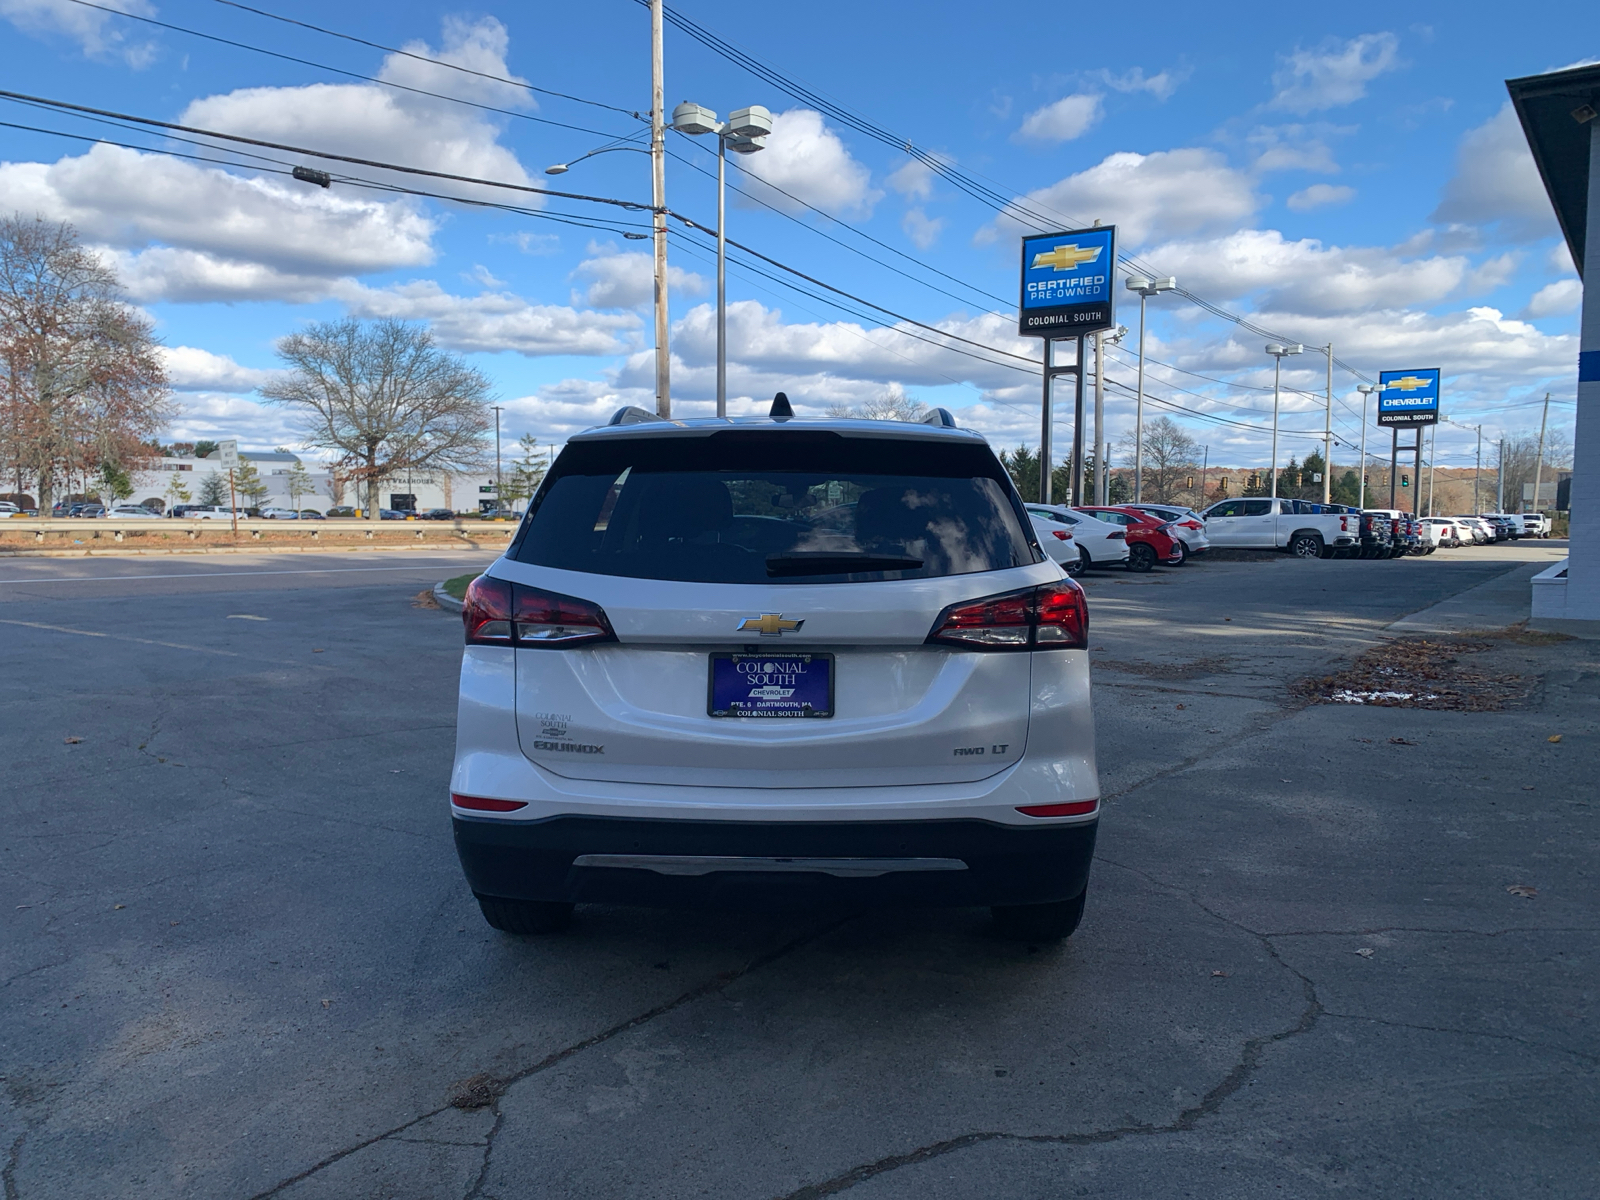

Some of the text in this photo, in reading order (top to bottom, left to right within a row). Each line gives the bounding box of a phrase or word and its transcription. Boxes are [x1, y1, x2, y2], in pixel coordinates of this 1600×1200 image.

[1027, 275, 1105, 292] CERTIFIED
[1030, 285, 1101, 300] PRE-OWNED
[1028, 311, 1102, 326] COLONIAL SOUTH
[1383, 397, 1435, 407] CHEVROLET
[736, 662, 807, 674] COLONIAL
[747, 673, 796, 685] SOUTH
[756, 701, 801, 709] DARTMOUTH,
[535, 712, 574, 722] COLONIAL
[540, 720, 567, 729] SOUTH
[533, 740, 605, 755] EQUINOX
[953, 744, 1010, 756] AWD LT
